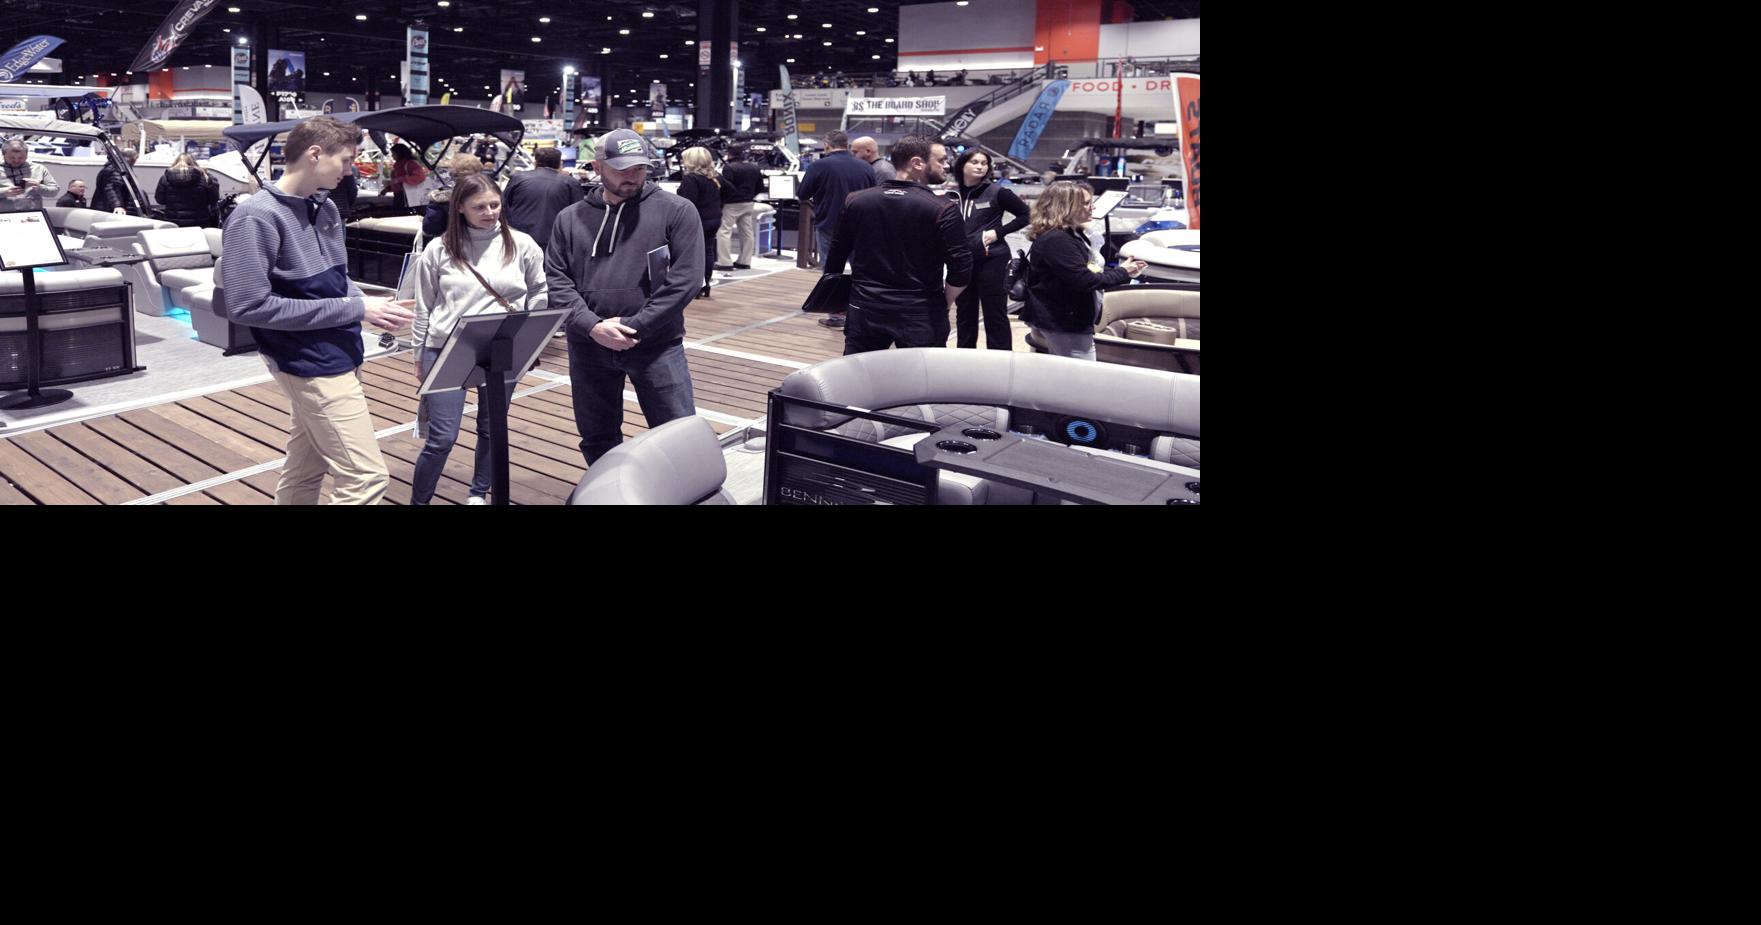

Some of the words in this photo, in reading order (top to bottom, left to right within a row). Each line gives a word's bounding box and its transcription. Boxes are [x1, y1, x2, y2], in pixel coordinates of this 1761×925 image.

[4, 39, 50, 72] EdgeWater
[1072, 82, 1123, 92] FOOD
[867, 100, 883, 109] THE
[781, 486, 836, 505] BENN
